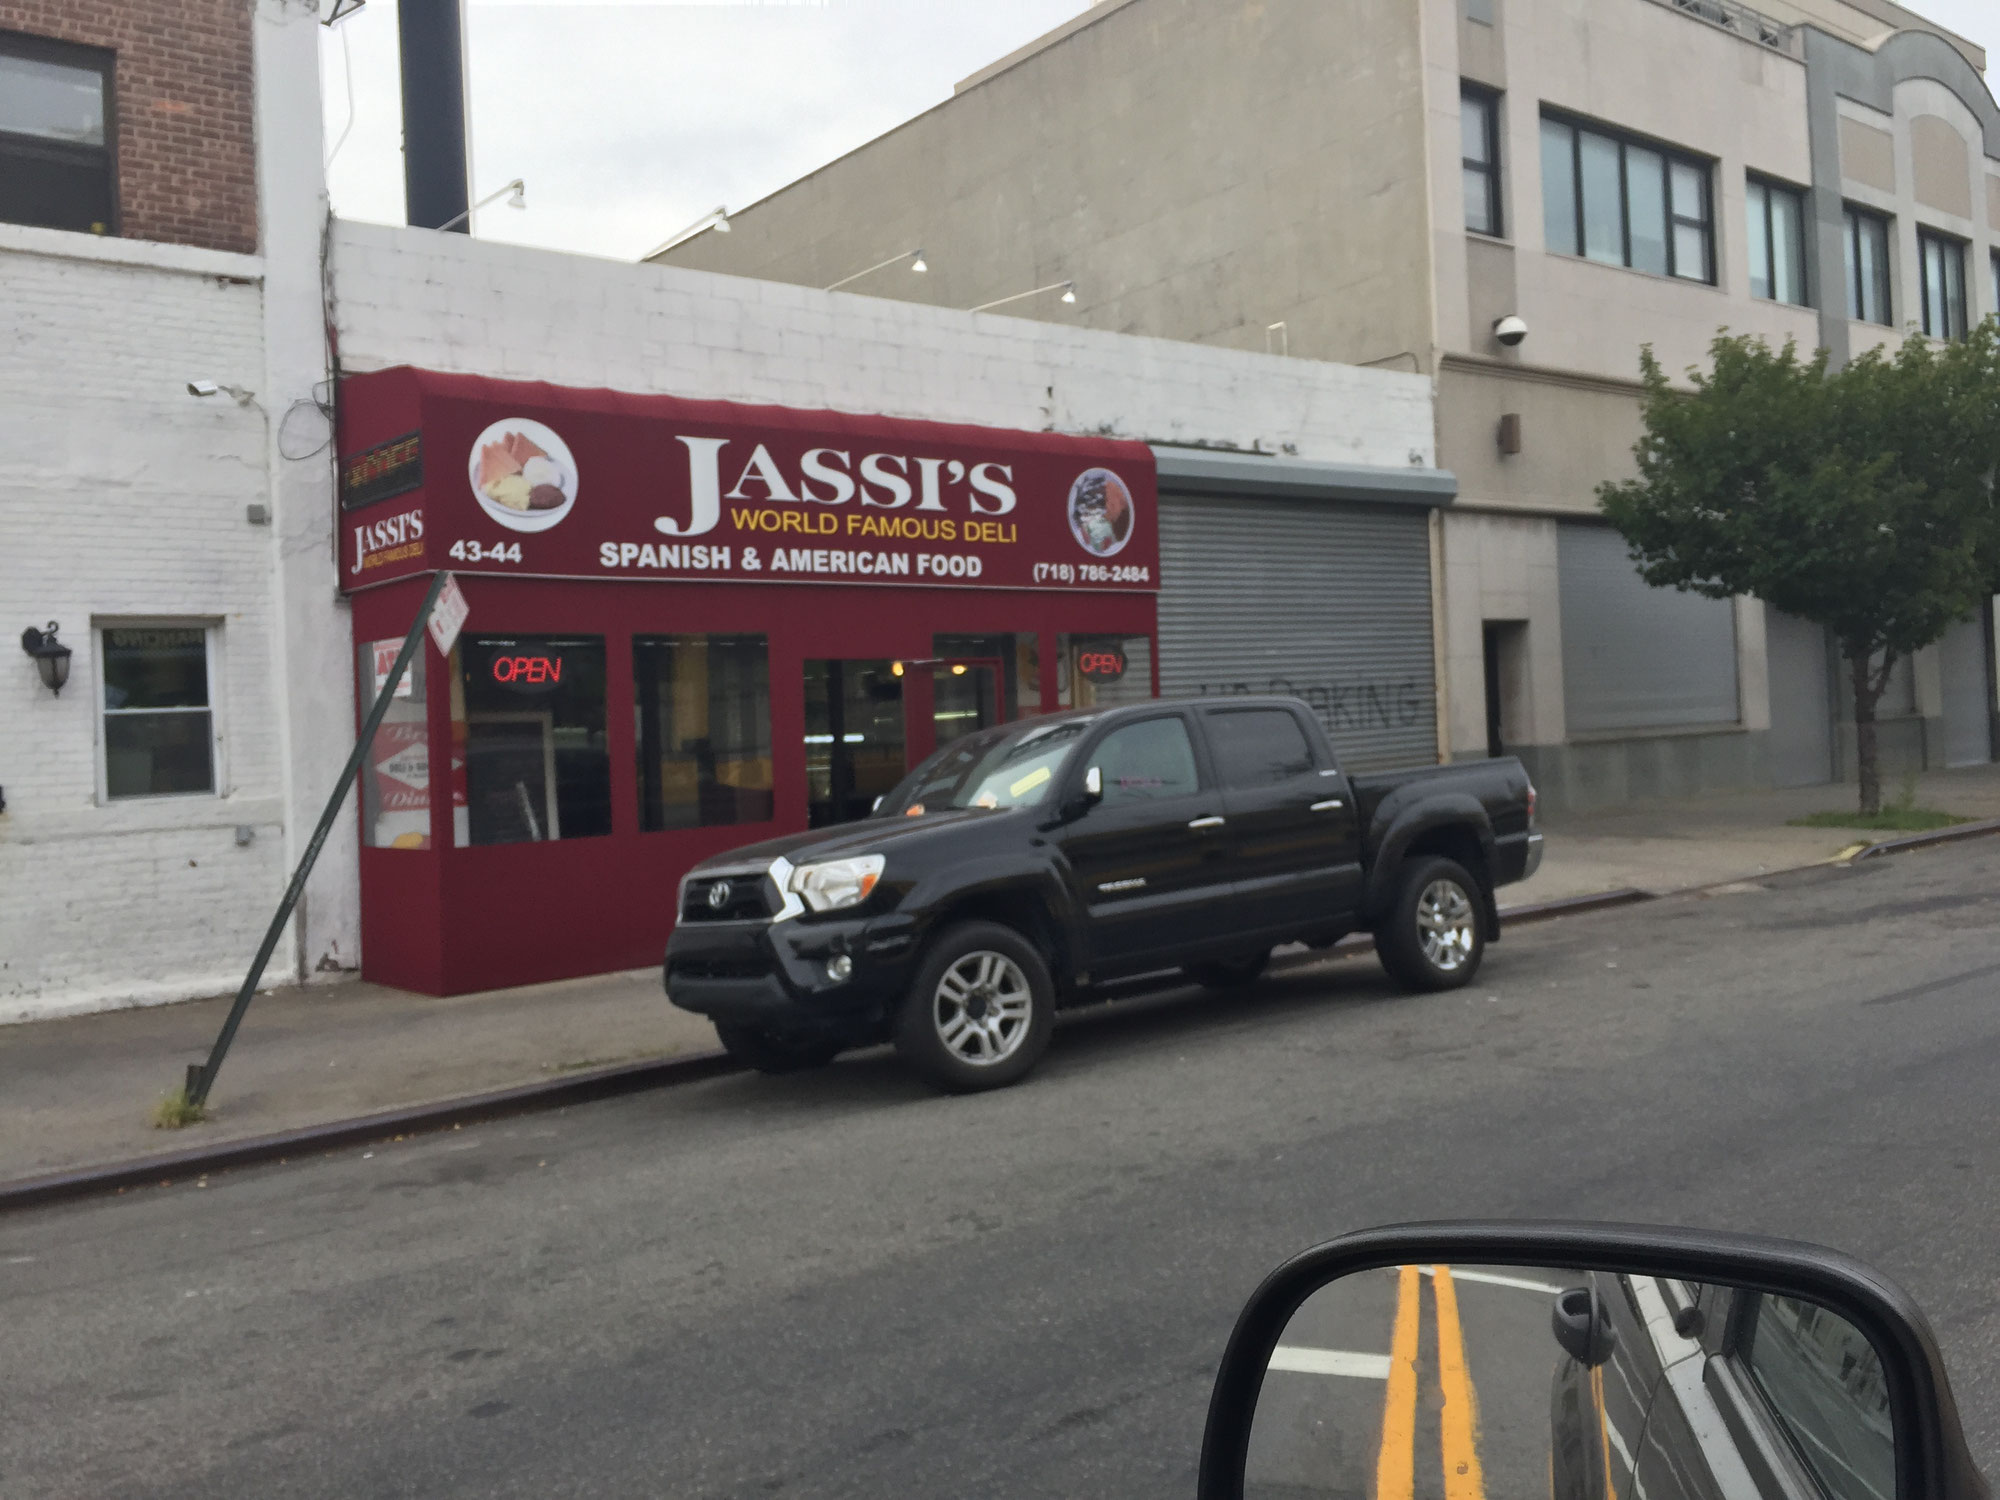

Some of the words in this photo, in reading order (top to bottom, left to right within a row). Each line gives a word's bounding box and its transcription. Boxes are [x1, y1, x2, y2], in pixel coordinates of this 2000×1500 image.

[654, 435, 1017, 537] JASSI'S
[731, 508, 838, 534] WORLD
[847, 515, 956, 540] FAMOUS
[964, 521, 1017, 543] DELI
[351, 509, 424, 575] JASSI'S
[449, 540, 522, 563] 43-44
[600, 542, 731, 570] SPANISH
[741, 546, 761, 570] &
[770, 548, 909, 575] AMERICAN
[917, 553, 982, 577] FOOD
[1033, 563, 1075, 584] (718)
[1079, 564, 1149, 582] 786-2484
[493, 657, 561, 683] OPEN
[1080, 653, 1124, 674] OPEN
